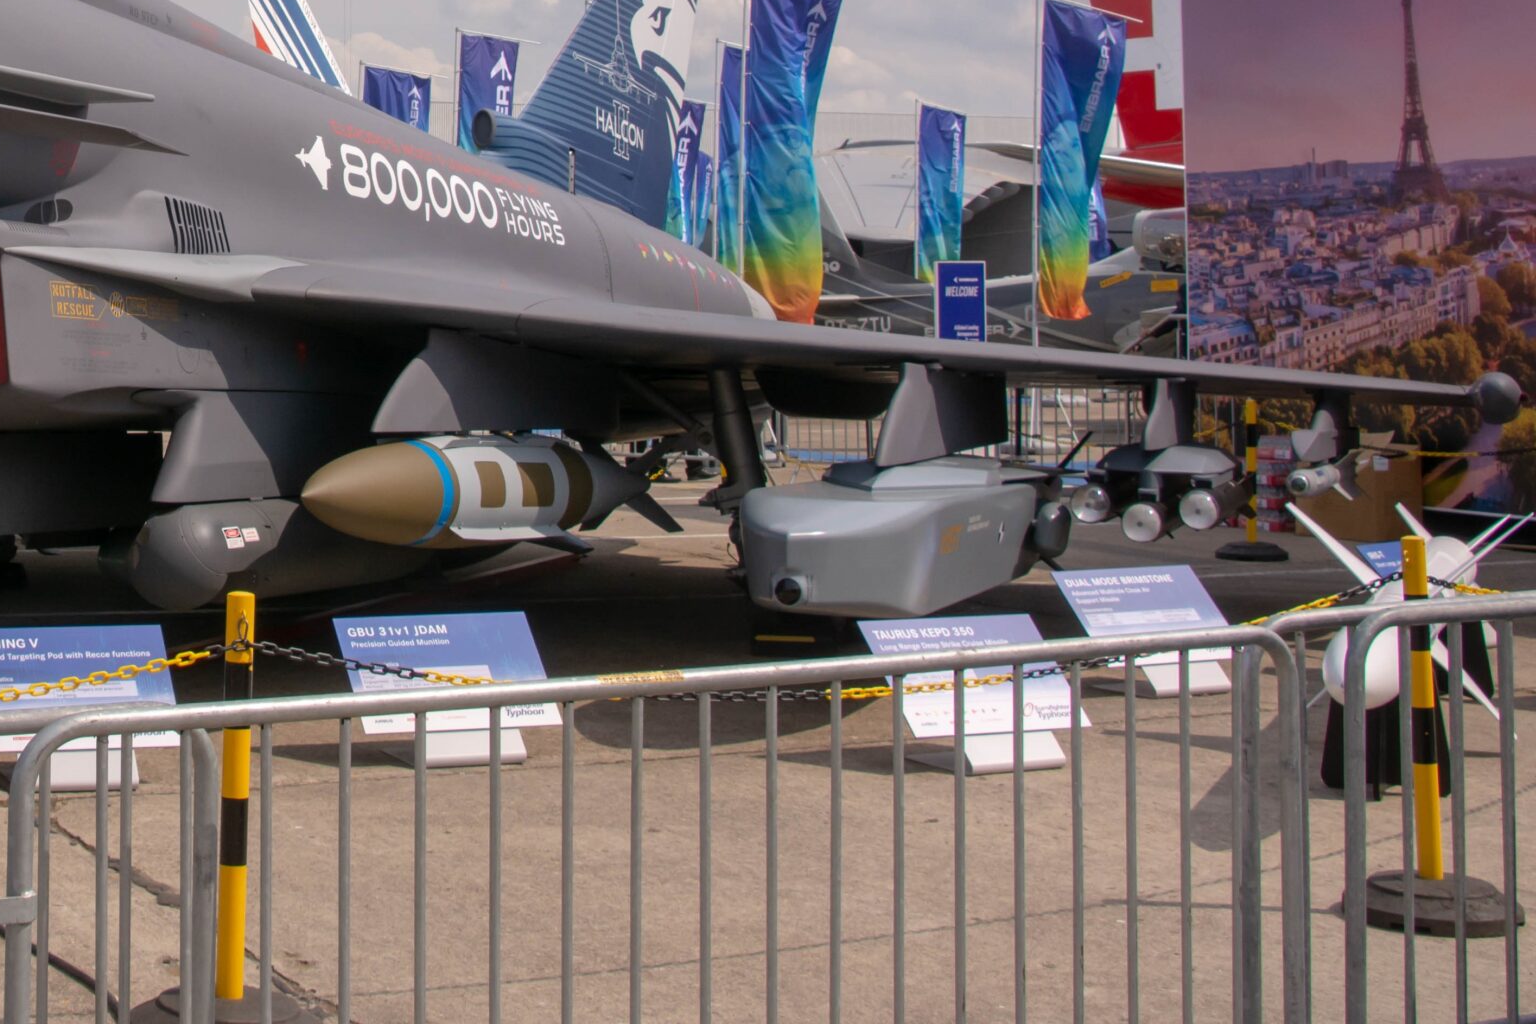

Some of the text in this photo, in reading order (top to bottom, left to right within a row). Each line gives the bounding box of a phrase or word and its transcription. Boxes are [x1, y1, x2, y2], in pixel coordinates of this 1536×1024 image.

[1080, 45, 1111, 133] EMBRAER
[595, 105, 644, 151] HALCON
[340, 143, 498, 229] 800,000
[495, 187, 556, 221] FLYING
[505, 213, 566, 246] HOURS
[52, 283, 97, 300] NOTFALL
[945, 285, 980, 297] WELCOME
[56, 301, 95, 317] RESCUE
[1064, 573, 1174, 588] DUAL MODE BRIMSTONE
[347, 627, 374, 638] GBU
[414, 624, 448, 636] JDAM
[871, 626, 975, 641] TAURUS KEPD 350
[28, 637, 39, 649] V
[350, 638, 451, 649] Precision Guided Munition
[6, 652, 46, 663] Targeting
[47, 651, 64, 660] Pod
[64, 650, 84, 659] with
[85, 650, 111, 659] Recce
[112, 649, 152, 658] functions
[505, 708, 544, 719] Typhoon
